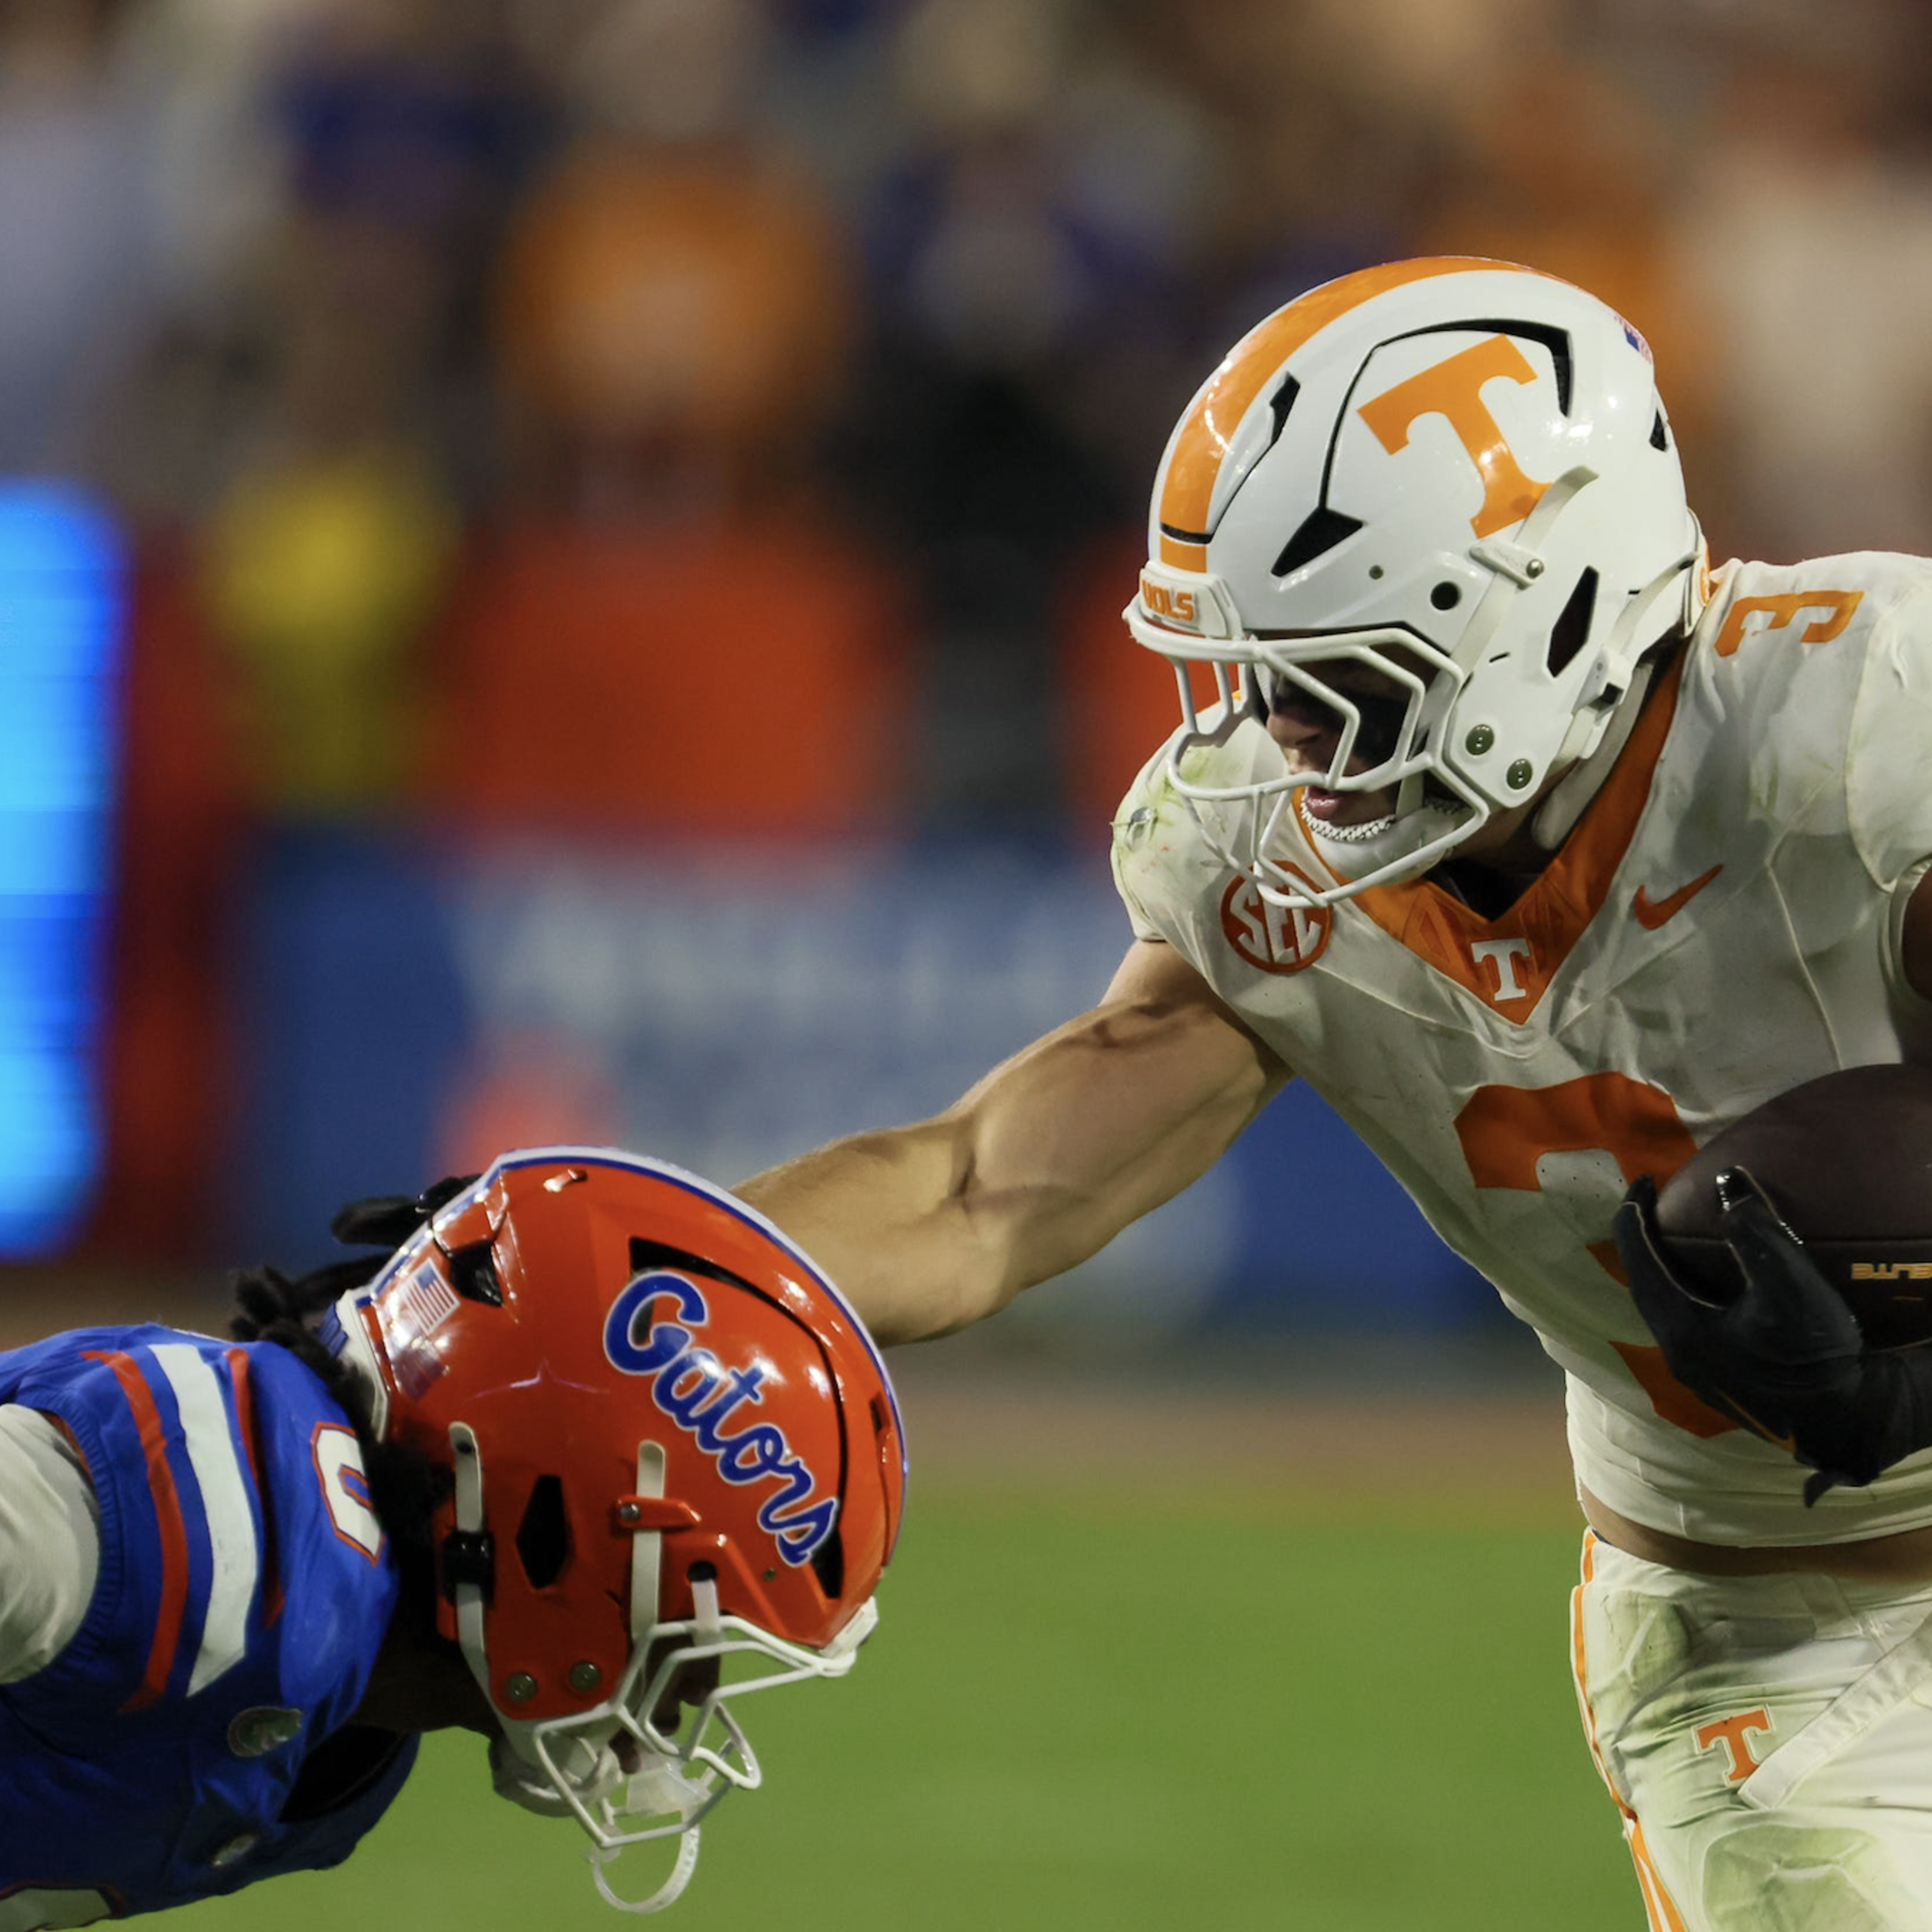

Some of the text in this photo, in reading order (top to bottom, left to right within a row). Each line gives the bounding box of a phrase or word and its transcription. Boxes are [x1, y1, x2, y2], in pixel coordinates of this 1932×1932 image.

[1356, 333, 1553, 539] T
[1142, 580, 1194, 621] VOLS
[1714, 590, 1865, 658] 3
[1230, 867, 1323, 963] SEC
[1471, 937, 1530, 1002] T
[603, 1270, 839, 1568] Gators
[1694, 1706, 1774, 1784] T
